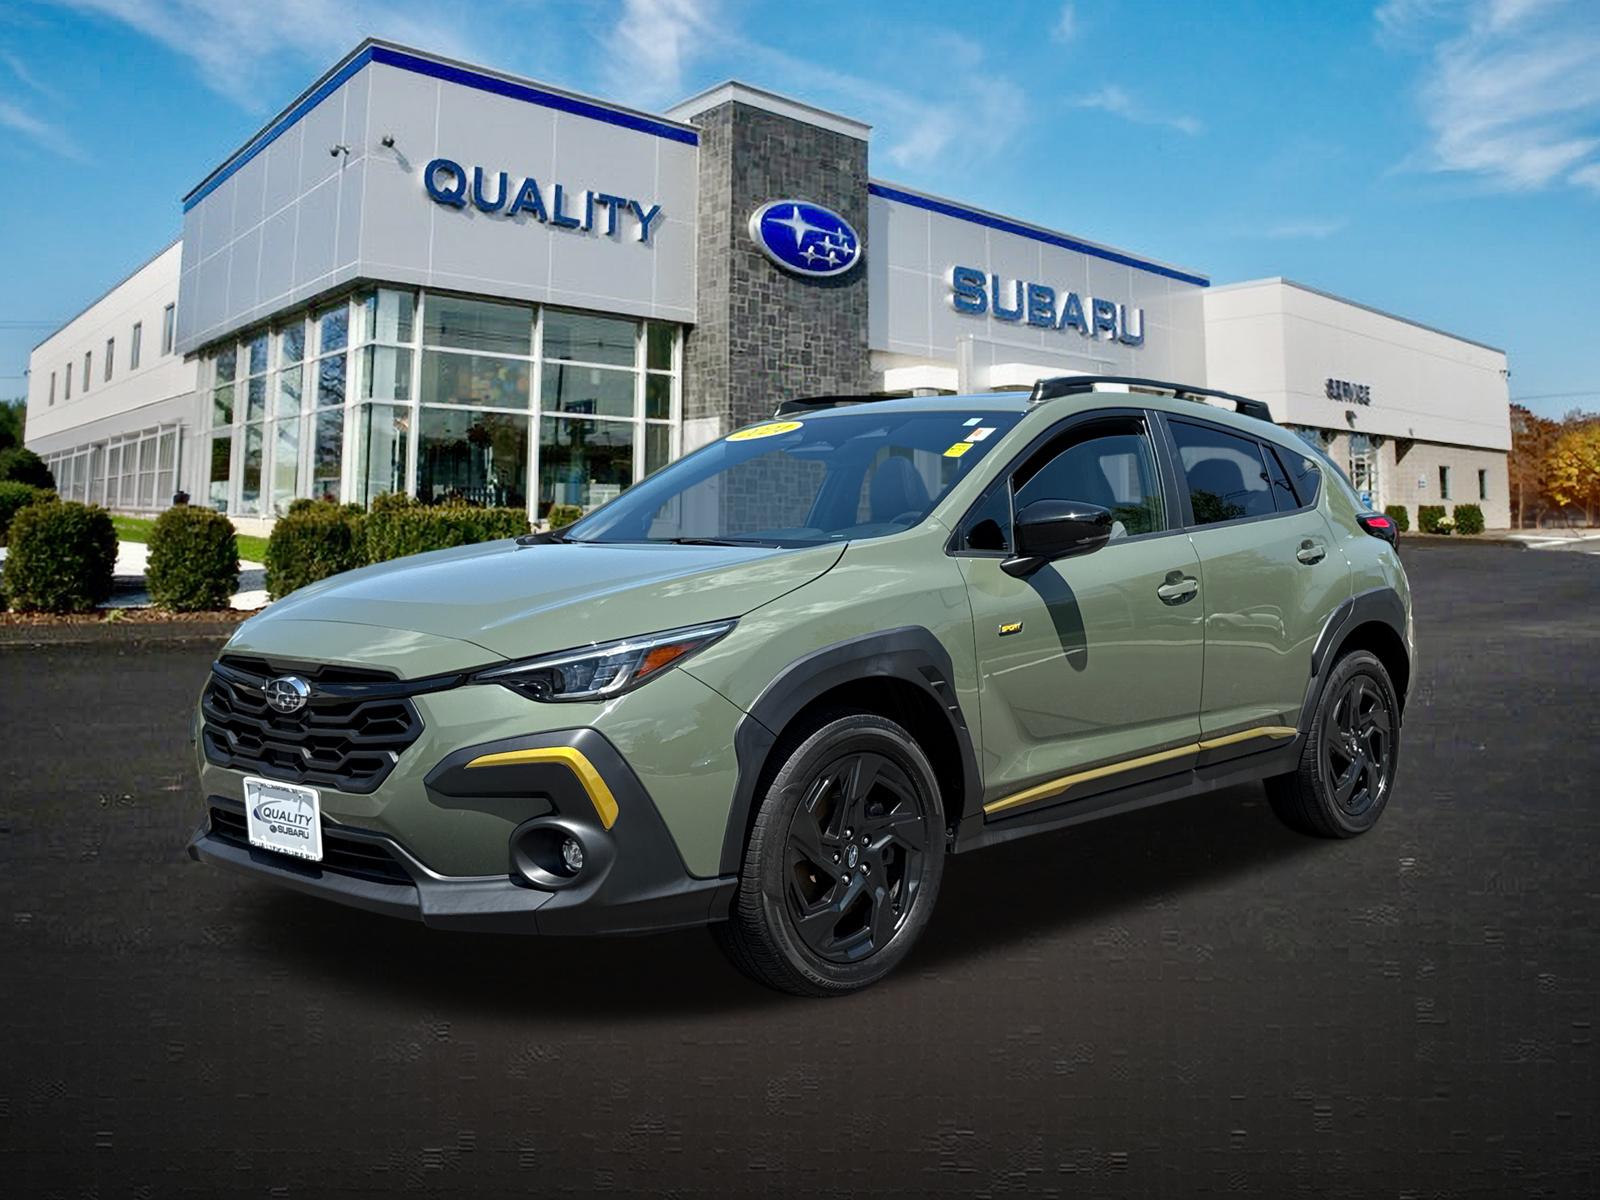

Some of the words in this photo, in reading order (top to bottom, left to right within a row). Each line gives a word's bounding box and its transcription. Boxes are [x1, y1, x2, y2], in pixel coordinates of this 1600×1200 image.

[424, 158, 661, 243] QUALITY
[949, 265, 1145, 347] SUBARU
[1325, 378, 1370, 406] SERVICE
[263, 807, 312, 826] QUALITY
[277, 825, 310, 839] SUBARU
